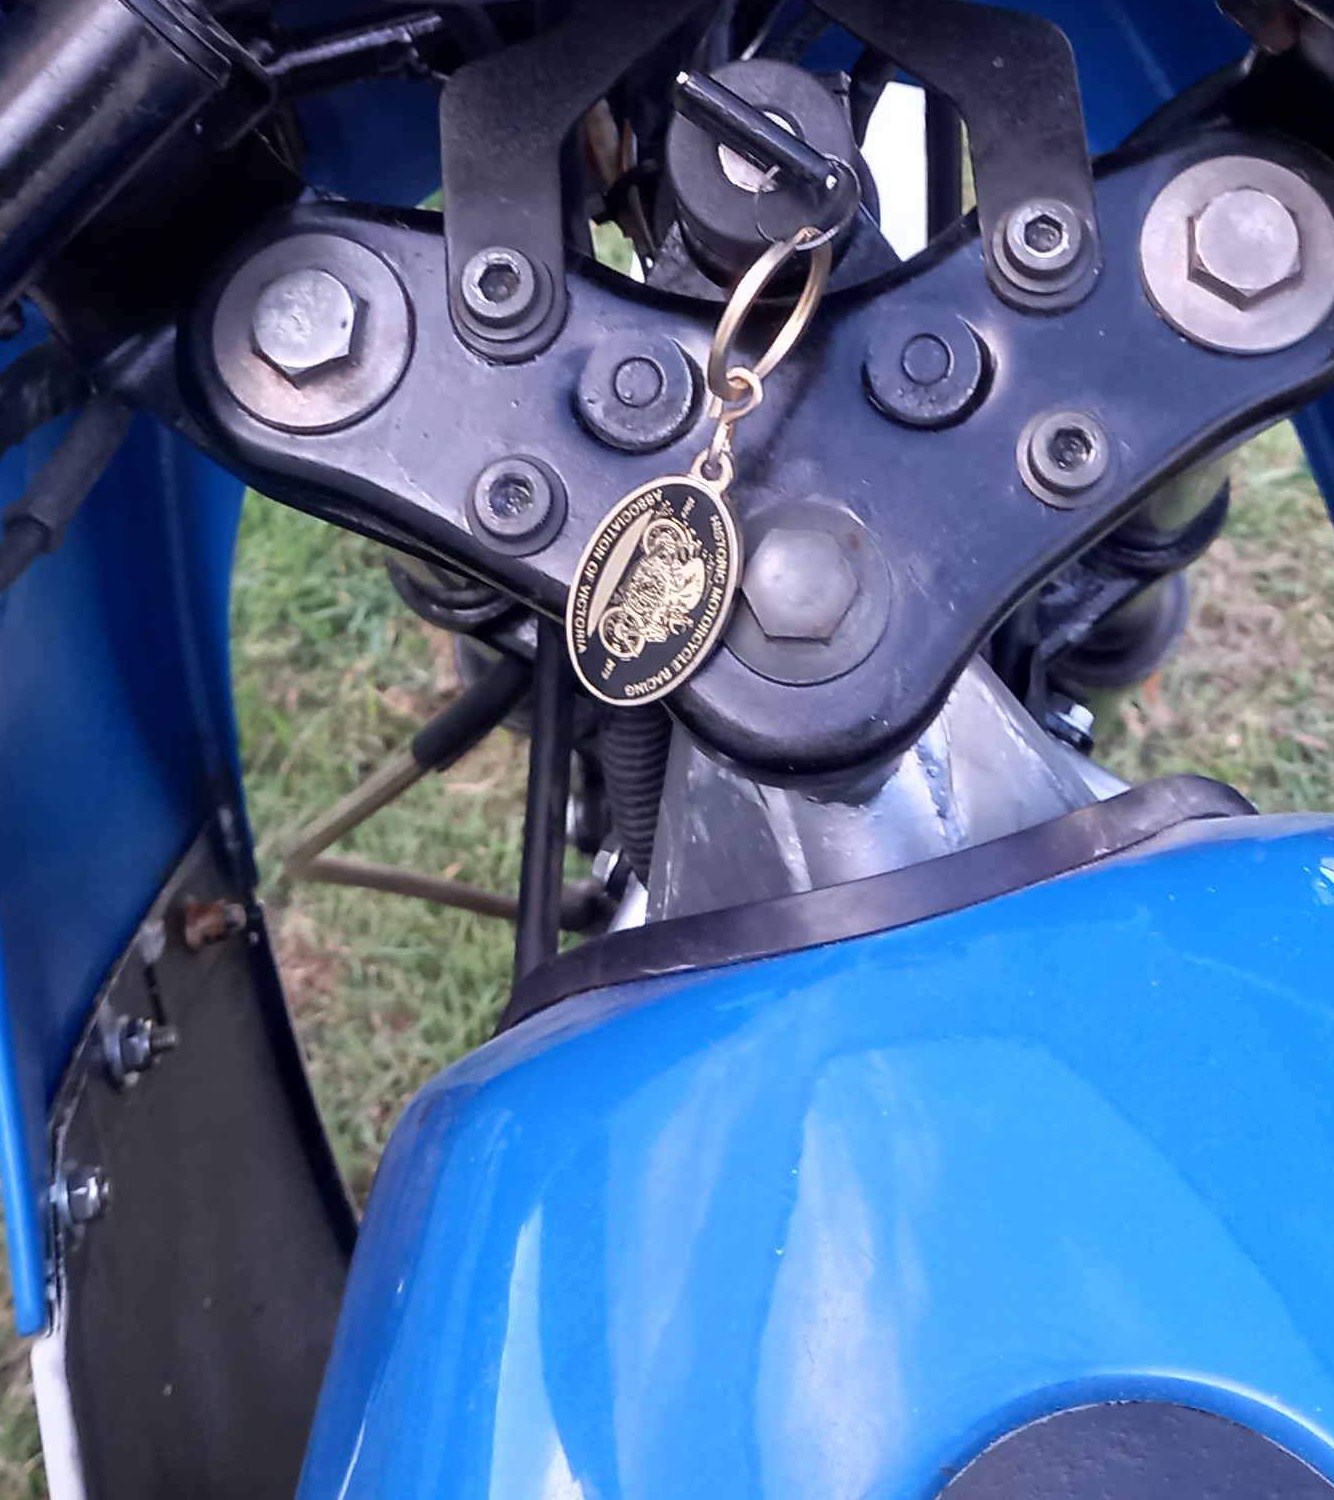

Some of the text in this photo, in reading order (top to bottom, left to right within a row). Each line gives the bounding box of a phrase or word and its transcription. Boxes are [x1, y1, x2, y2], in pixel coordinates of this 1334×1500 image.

[574, 488, 663, 654] ASSOCIATION OF VICTORIA
[624, 514, 728, 697] HISTORIC MOTORCYCLE RACING
